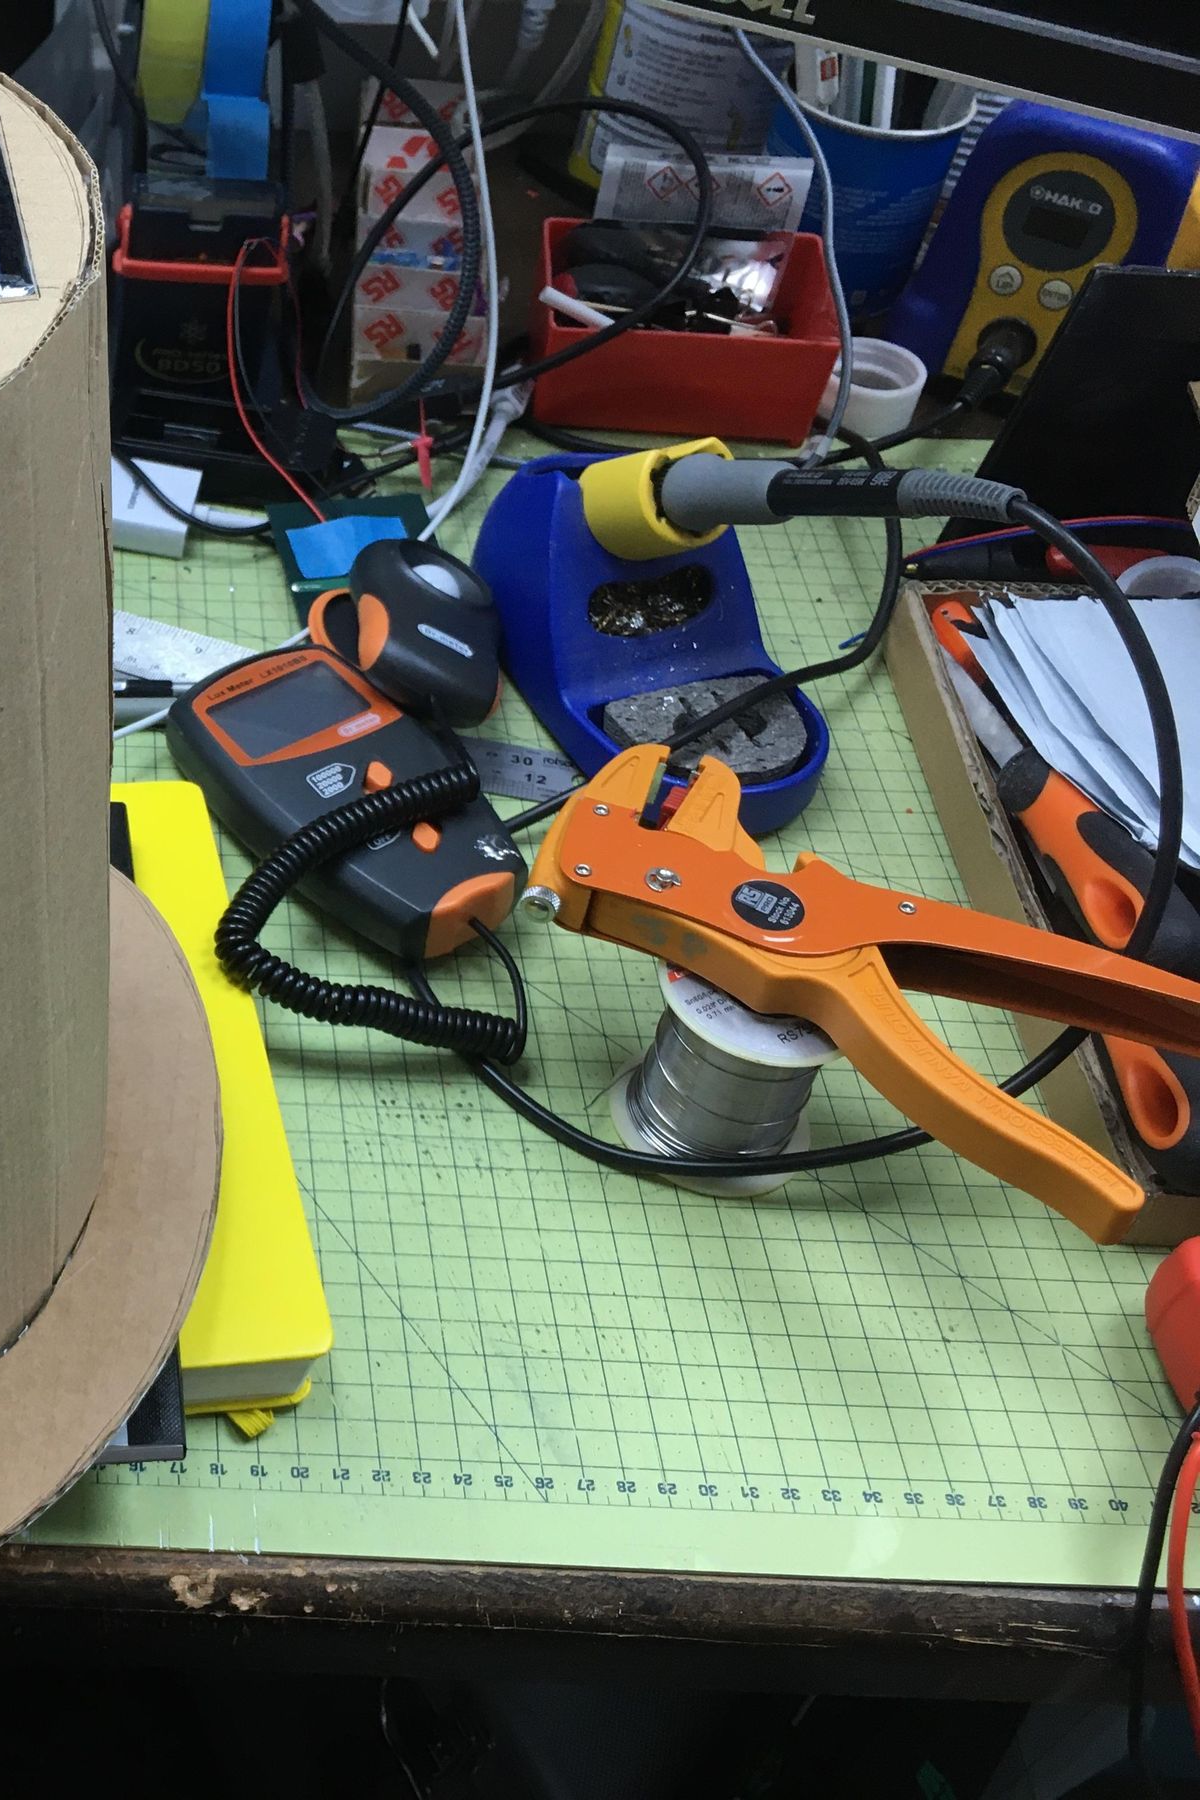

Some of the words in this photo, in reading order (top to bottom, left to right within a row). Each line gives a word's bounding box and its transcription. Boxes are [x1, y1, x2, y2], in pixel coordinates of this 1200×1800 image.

[361, 270, 400, 303] RS
[363, 313, 404, 350] RS
[226, 678, 253, 692] Meter
[510, 754, 533, 766] 30
[311, 765, 342, 782] 100000
[316, 773, 343, 789] 20000
[524, 773, 547, 784] 12
[322, 781, 344, 796] 2000
[737, 886, 762, 906] RS
[760, 896, 774, 912] PRO
[170, 1461, 188, 1474] 17
[209, 1463, 228, 1475] 18
[250, 1465, 268, 1477] 19
[290, 1467, 309, 1479] 20
[332, 1468, 350, 1480] 21
[372, 1469, 391, 1482] 22
[412, 1471, 431, 1484] 23
[453, 1473, 472, 1486] 24
[494, 1475, 513, 1488] 25
[535, 1477, 554, 1489] 26
[577, 1479, 595, 1491] 27
[616, 1480, 636, 1493] 28
[657, 1482, 677, 1495] 29
[698, 1484, 718, 1497] 30
[740, 1485, 760, 1499] 31
[781, 1487, 801, 1501] 32
[821, 1489, 842, 1502] 33
[862, 1490, 883, 1504] 34
[904, 1492, 924, 1505] 35
[945, 1493, 965, 1506] 36
[988, 1494, 1007, 1508] 37
[1027, 1496, 1048, 1509] 38
[1068, 1497, 1088, 1510] 39
[1108, 1498, 1128, 1512] 40
